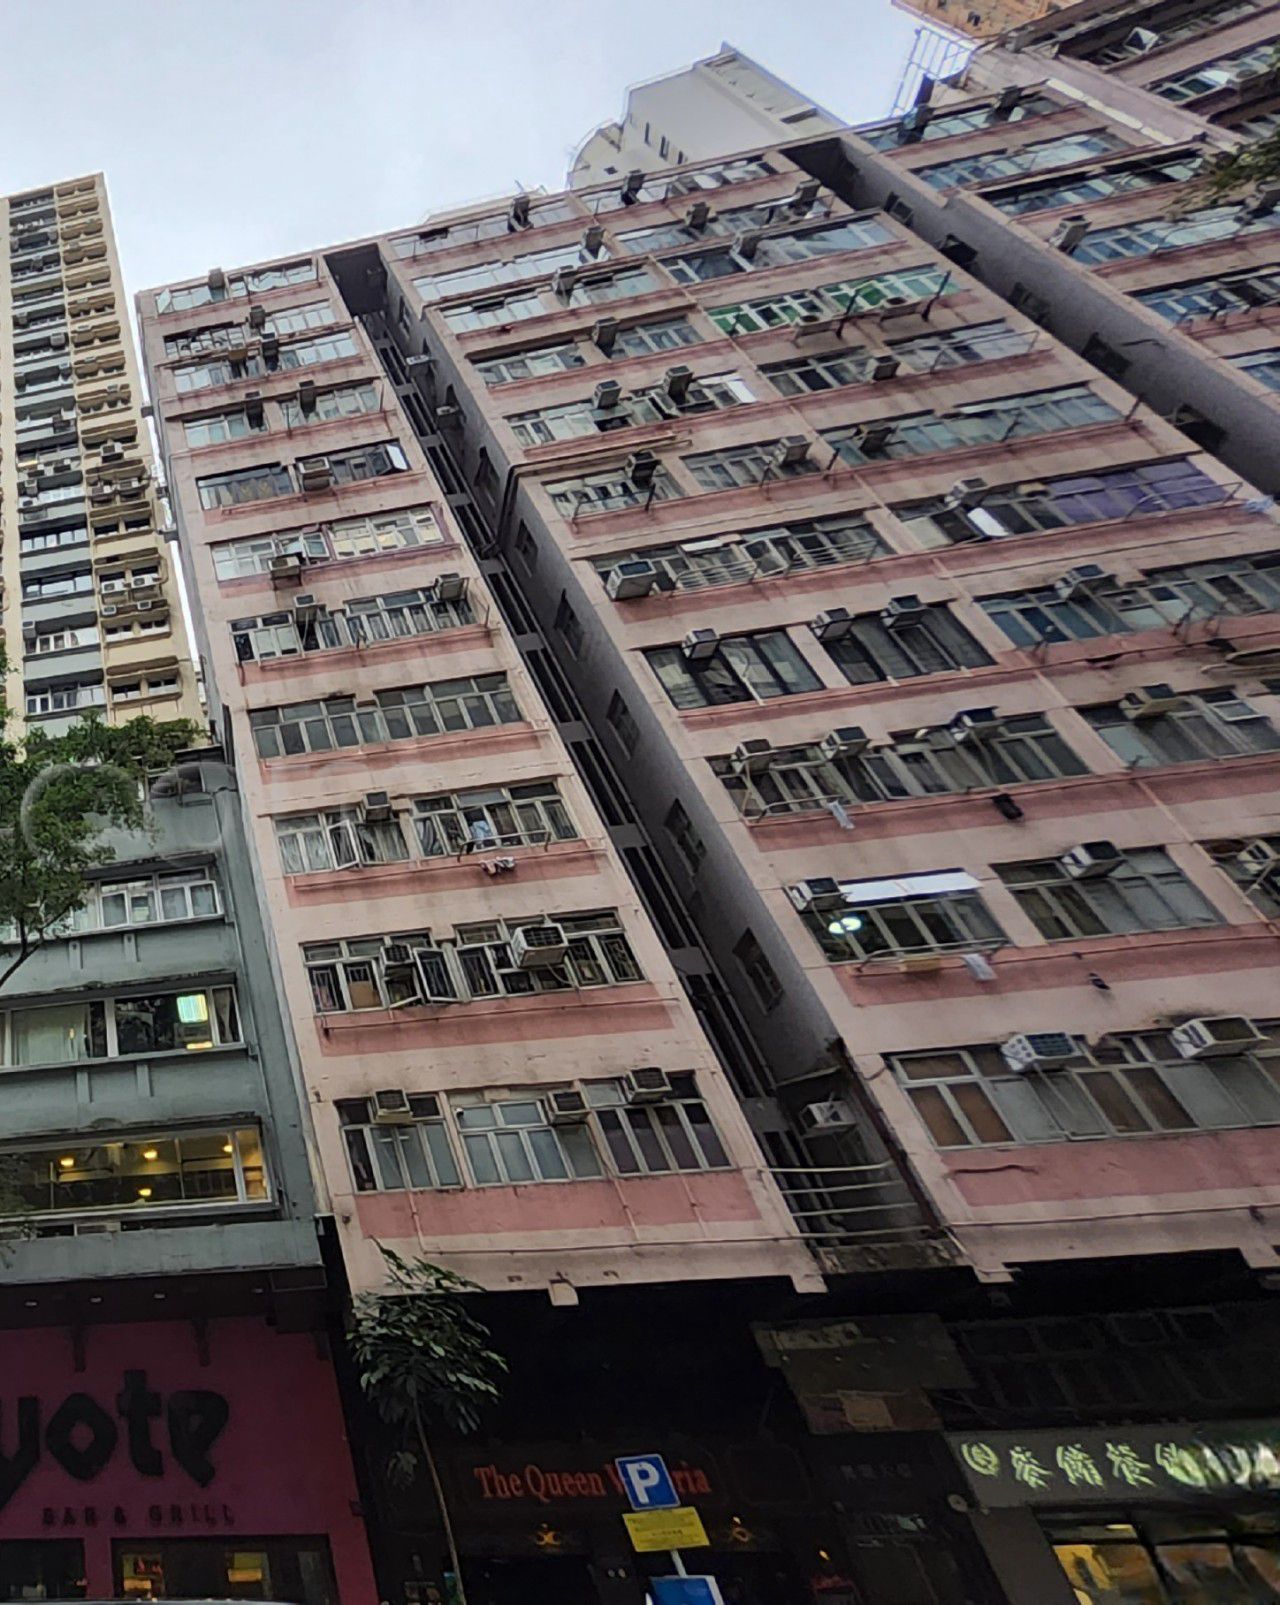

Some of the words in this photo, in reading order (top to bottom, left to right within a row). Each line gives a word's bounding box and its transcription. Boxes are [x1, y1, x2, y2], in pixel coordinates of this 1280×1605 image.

[476, 1465, 523, 1498] The
[525, 1464, 606, 1503] Queen
[604, 1460, 712, 1497] Vria
[626, 1462, 659, 1503] P
[41, 1507, 98, 1529] BAR
[113, 1506, 127, 1526] &
[148, 1504, 235, 1527] GRILL
